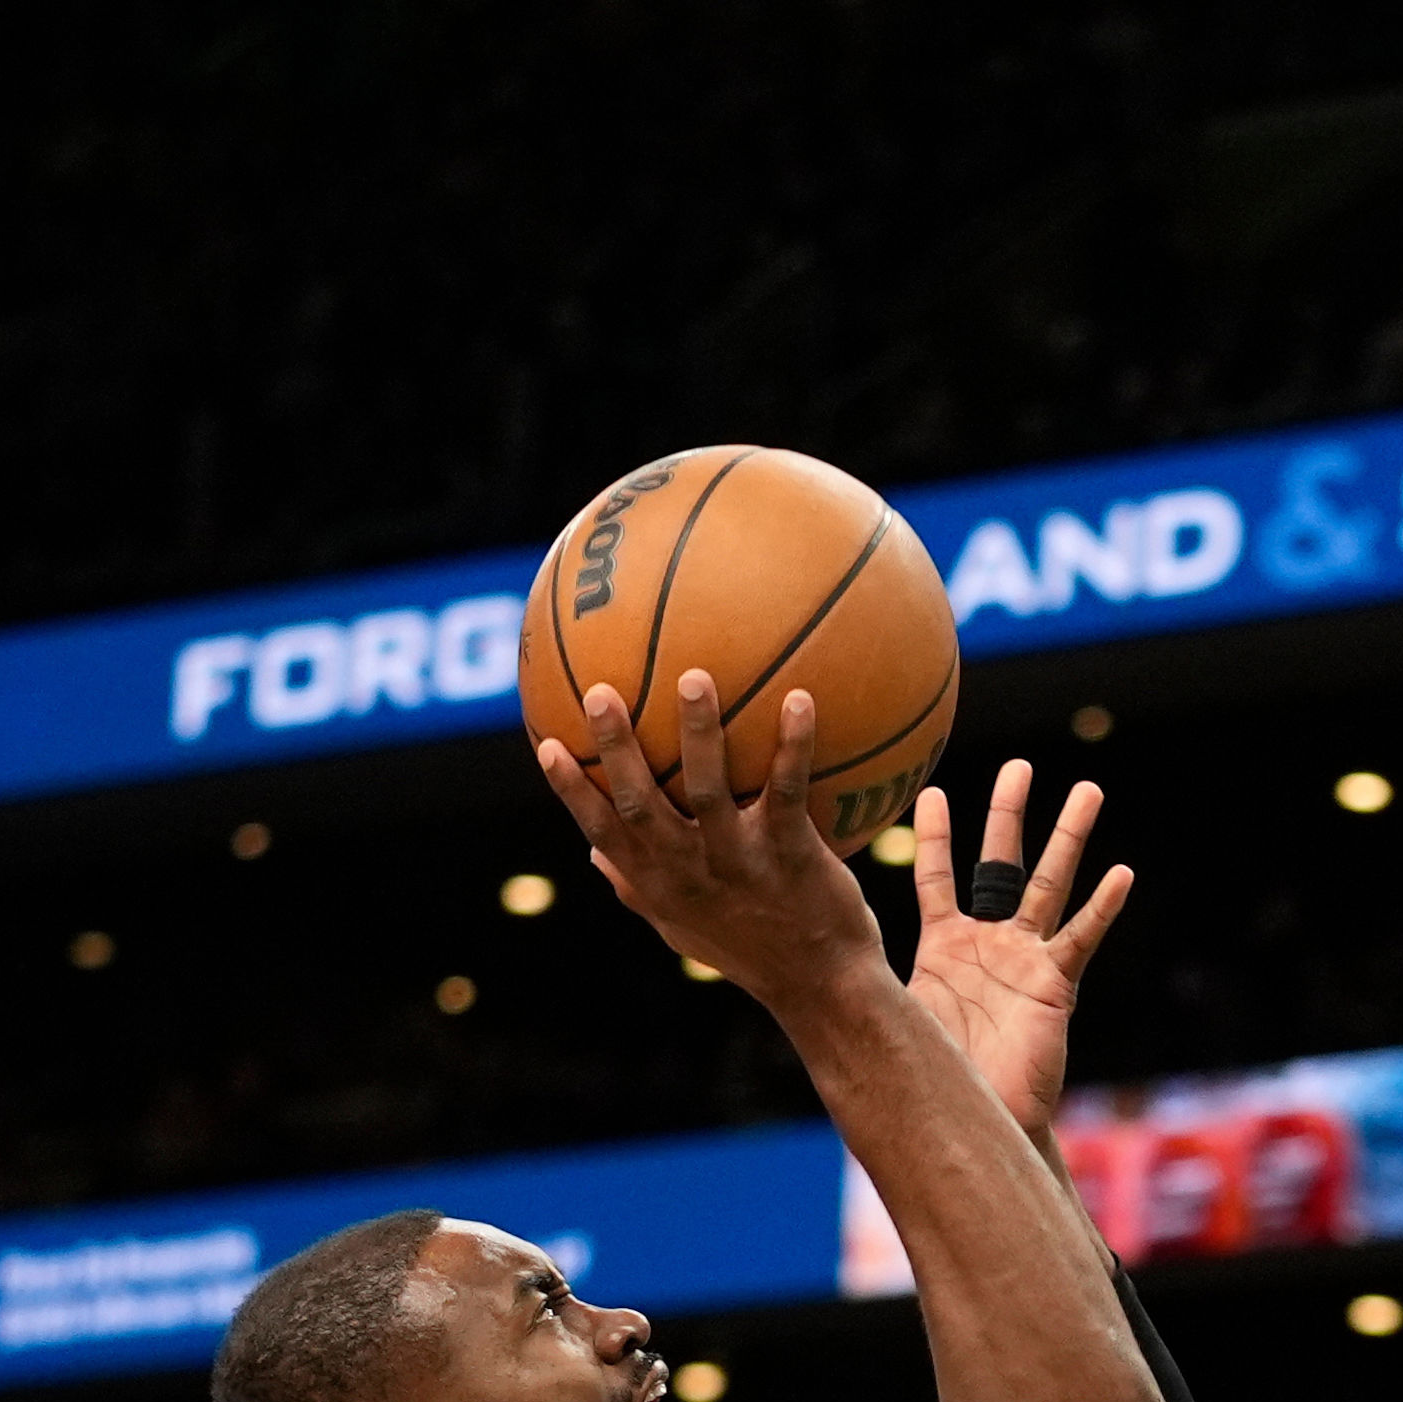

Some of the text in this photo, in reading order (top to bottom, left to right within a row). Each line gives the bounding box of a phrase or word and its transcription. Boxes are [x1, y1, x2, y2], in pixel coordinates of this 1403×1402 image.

[171, 594, 524, 741] FORG
[947, 488, 1243, 626] AND
[1256, 442, 1384, 588] &
